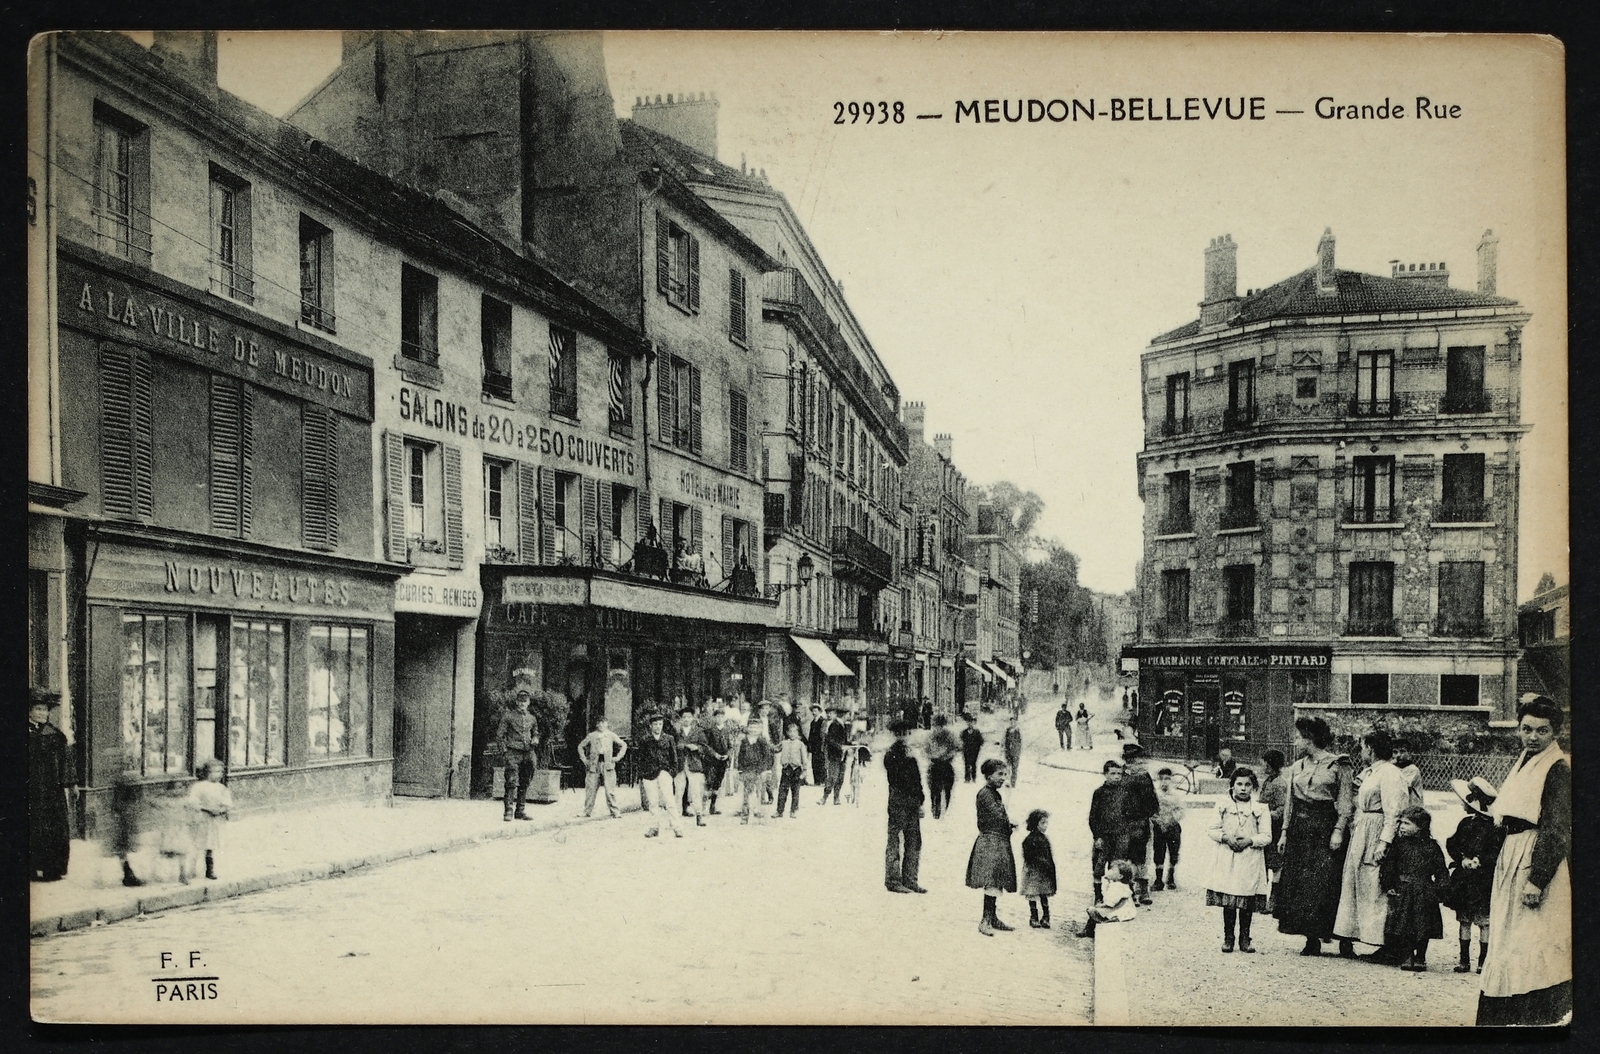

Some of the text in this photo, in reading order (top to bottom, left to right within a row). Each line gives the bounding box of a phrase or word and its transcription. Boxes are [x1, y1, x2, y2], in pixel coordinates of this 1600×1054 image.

[79, 282, 352, 397] A LA VILLE DE MEUDON
[400, 387, 467, 436] SALONS
[472, 414, 485, 440] de
[488, 414, 514, 446] 20
[526, 424, 564, 458] 250
[568, 434, 634, 476] COUVERTS
[443, 587, 477, 608] REMISES
[1147, 656, 1201, 666] PHARMACIE
[1207, 656, 1259, 666] CENTRALE
[1270, 654, 1328, 666] PINTARD
